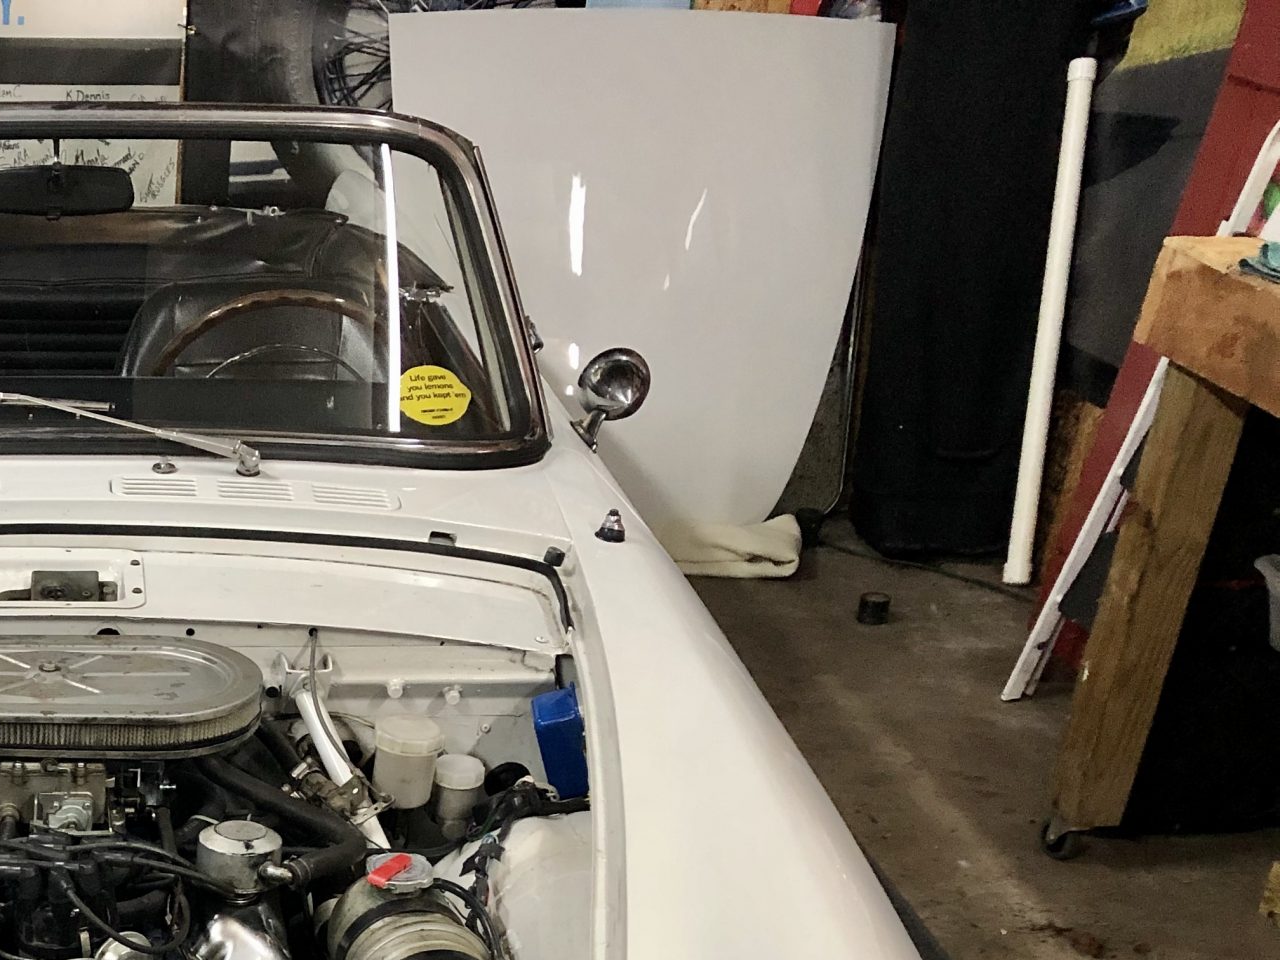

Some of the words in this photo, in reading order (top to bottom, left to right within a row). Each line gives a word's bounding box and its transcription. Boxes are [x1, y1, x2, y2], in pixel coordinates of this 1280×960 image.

[409, 374, 426, 382] Life
[407, 385, 423, 393] you
[415, 394, 432, 402] you
